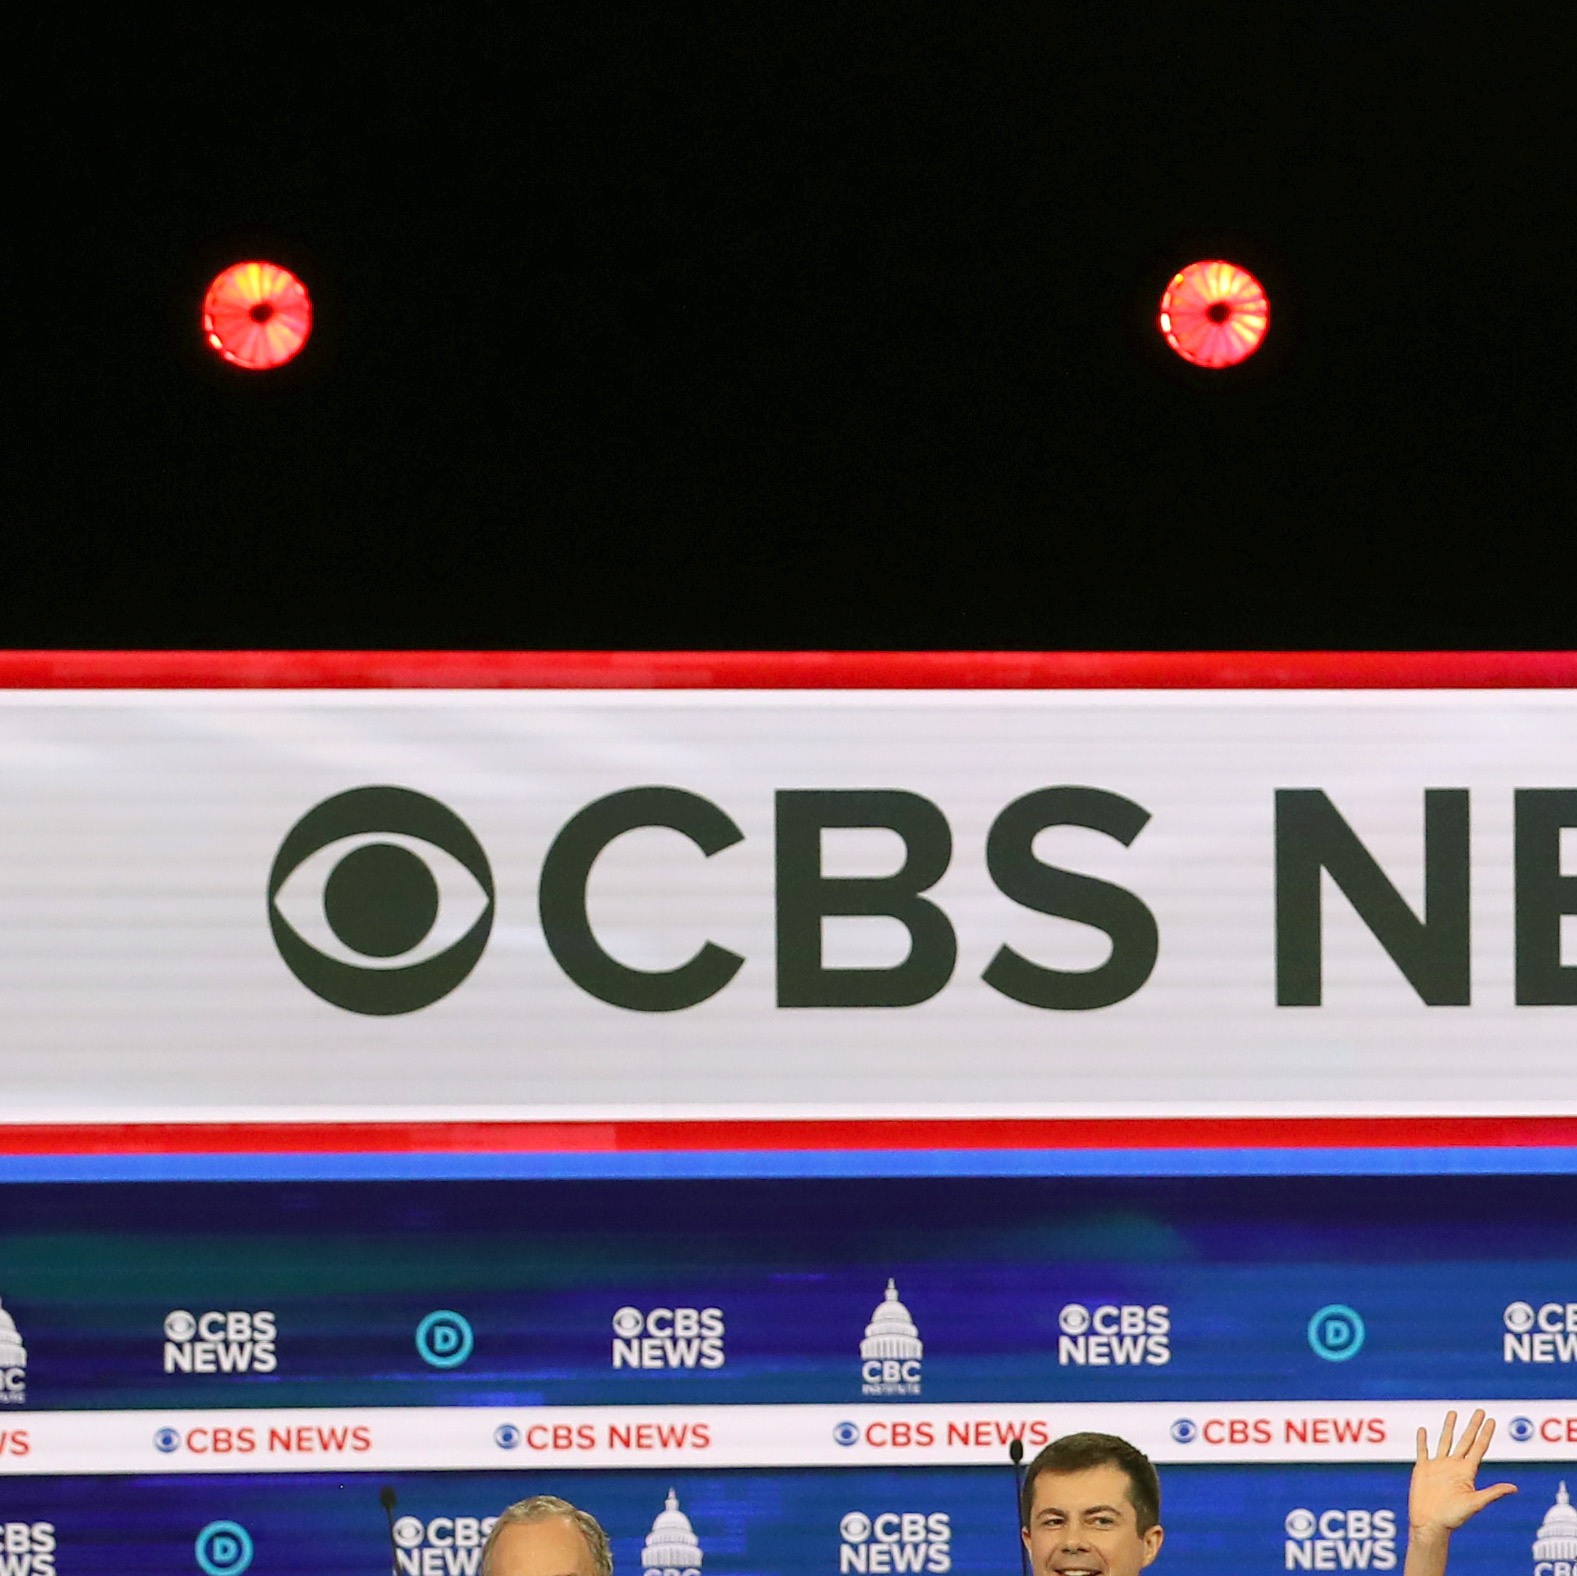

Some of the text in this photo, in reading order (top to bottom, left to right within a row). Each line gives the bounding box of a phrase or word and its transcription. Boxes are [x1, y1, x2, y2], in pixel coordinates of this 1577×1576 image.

[539, 787, 1158, 1012] CBS
[200, 1311, 276, 1341] CBS
[647, 1308, 725, 1338] CBS
[1092, 1305, 1169, 1335] CBS
[1325, 1320, 1350, 1346] D
[433, 1326, 459, 1352] D
[614, 1338, 725, 1369] NEWS
[1059, 1336, 1170, 1366] NEWS
[164, 1342, 276, 1373] NEWS
[862, 1361, 921, 1383] CBC
[187, 1427, 371, 1453] CBS NEWS
[527, 1424, 710, 1450] CBS NEWS
[866, 1421, 1049, 1447] CBS NEWS
[1204, 1419, 1386, 1444] CBS NEWS
[0, 1522, 56, 1552] BS
[875, 1513, 950, 1543] CBS
[1319, 1510, 1396, 1540] CBS
[213, 1537, 238, 1563] D
[841, 1544, 951, 1574] NEWS
[1286, 1541, 1396, 1571] NEWS
